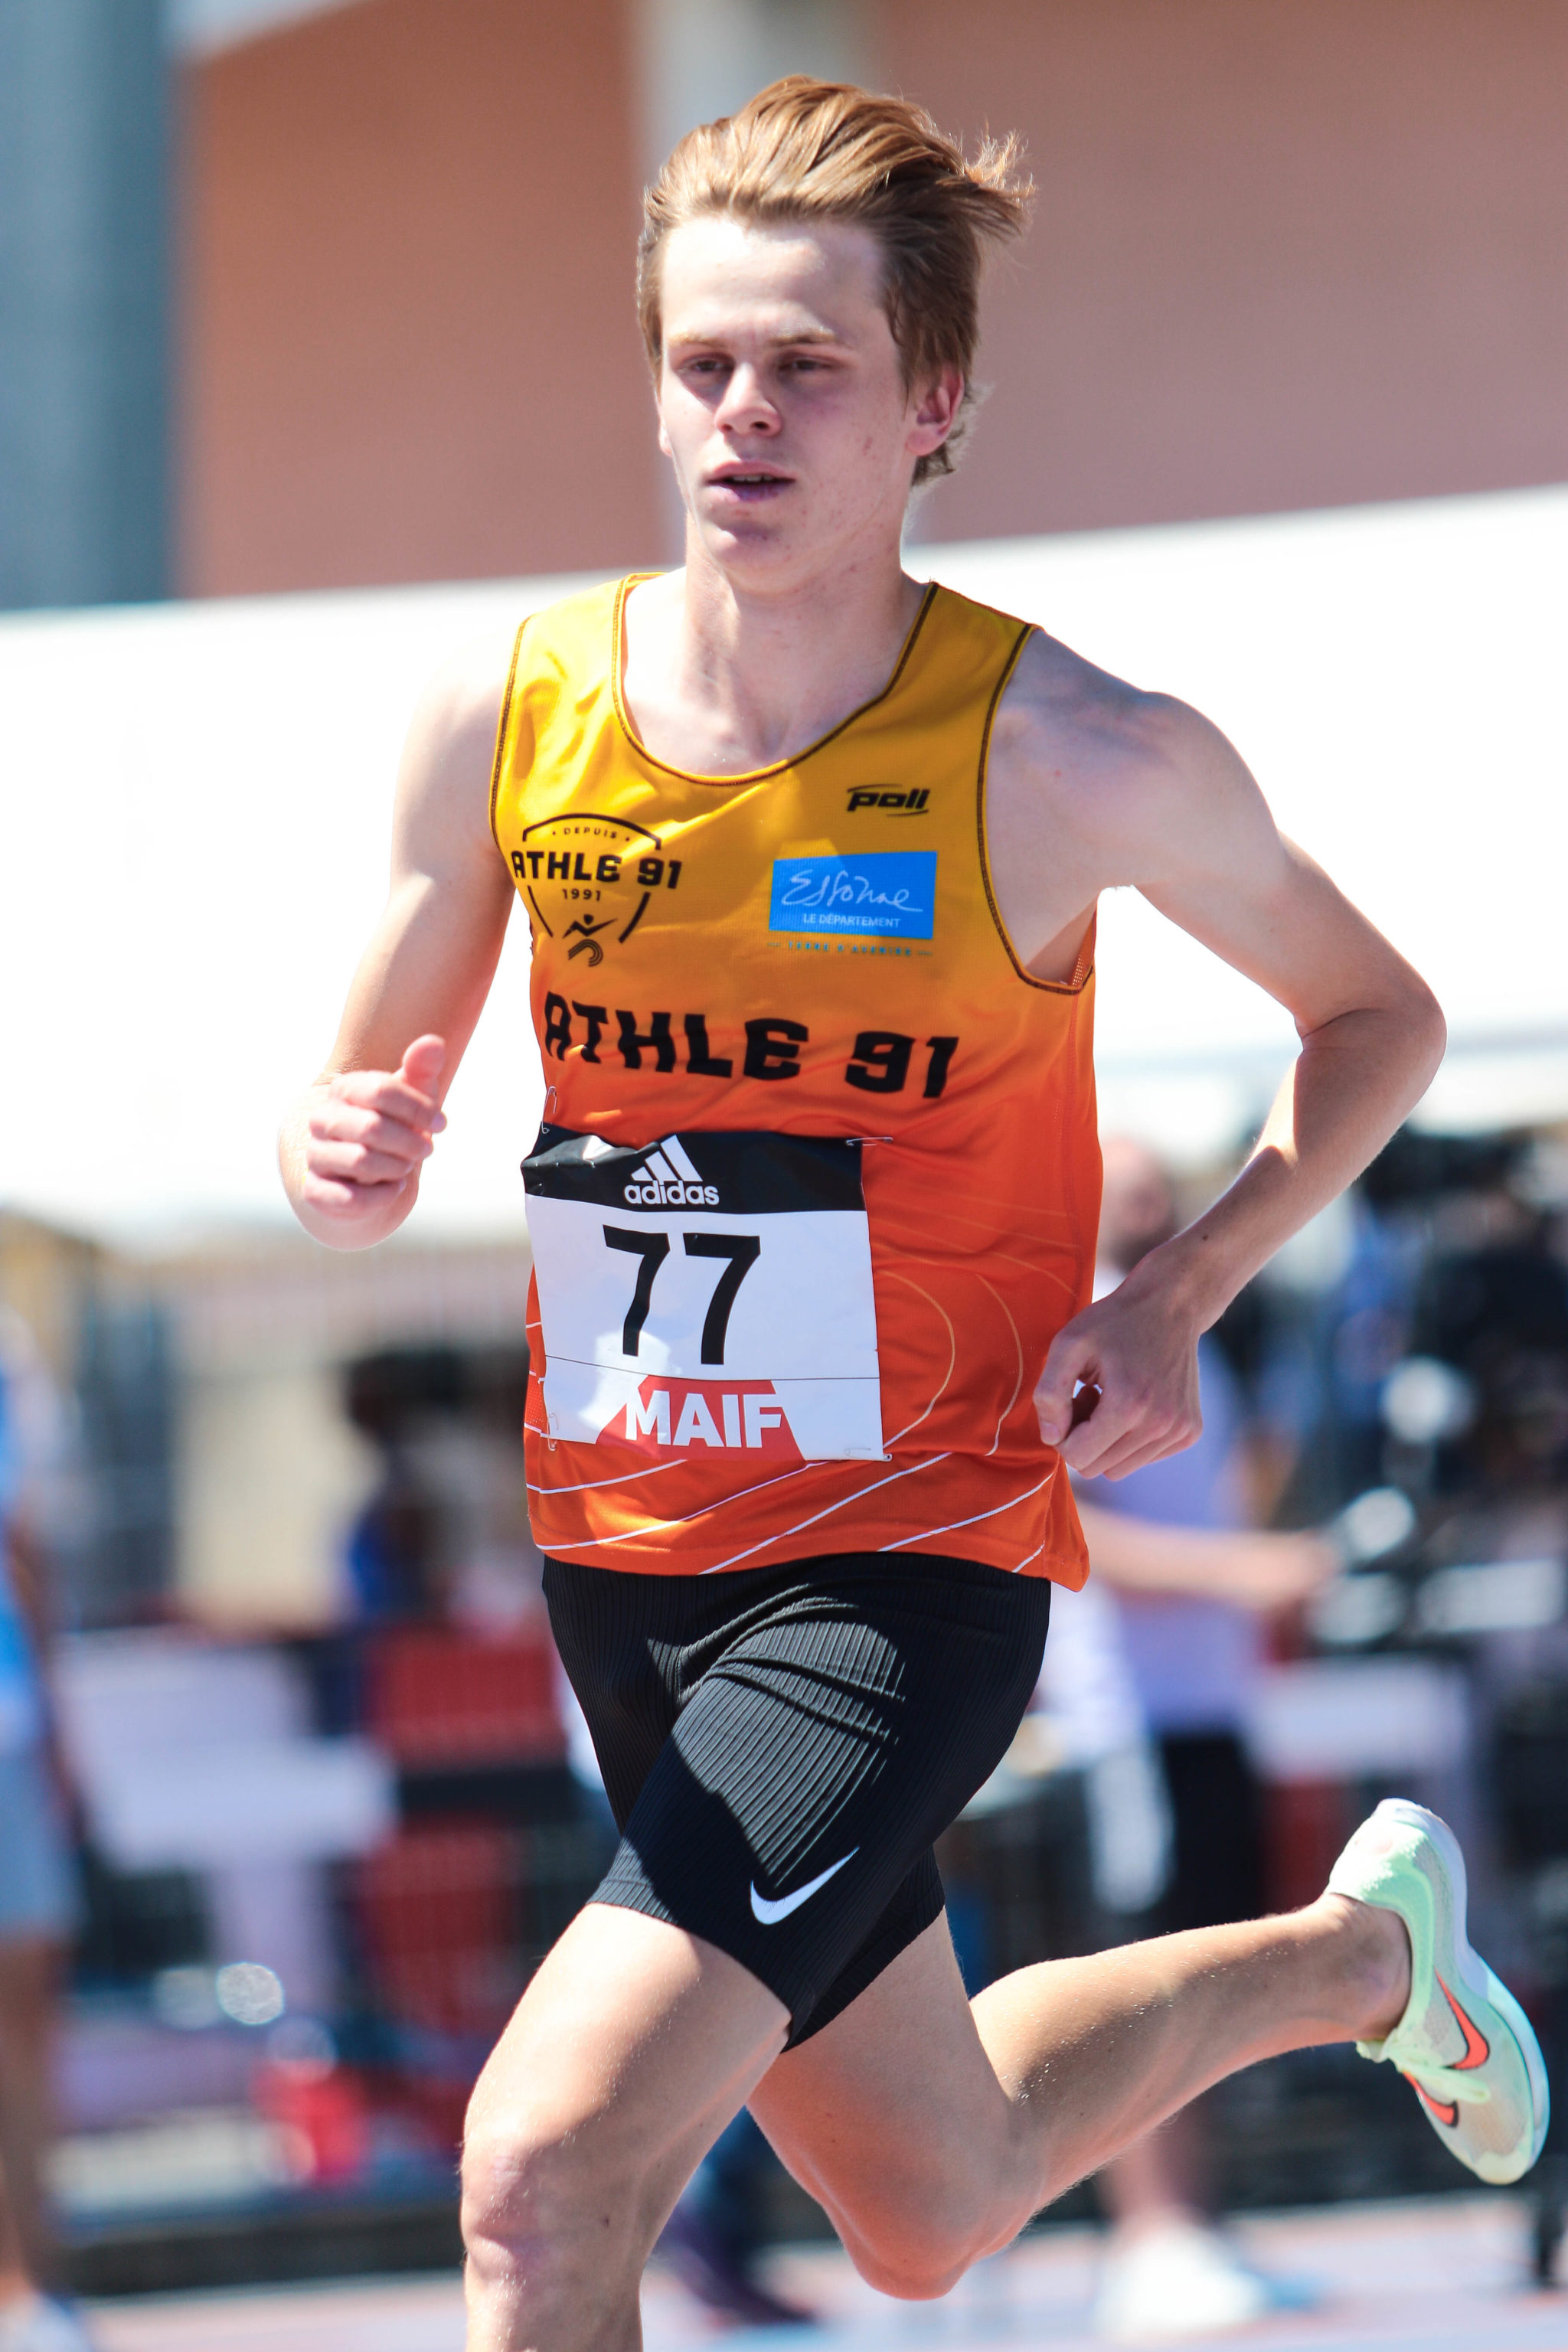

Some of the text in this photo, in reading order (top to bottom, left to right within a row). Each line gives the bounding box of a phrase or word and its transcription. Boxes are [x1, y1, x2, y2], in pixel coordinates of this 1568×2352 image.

[847, 788, 930, 812] poll
[564, 827, 617, 839] DEPUIS
[637, 858, 682, 889] 91
[562, 888, 601, 901] 1991
[804, 913, 901, 928] LE DÉPARTEMENT
[844, 1031, 959, 1098] 91
[624, 1180, 720, 1206] adidas
[603, 1224, 761, 1365] 77
[625, 1390, 782, 1449] MAIF
